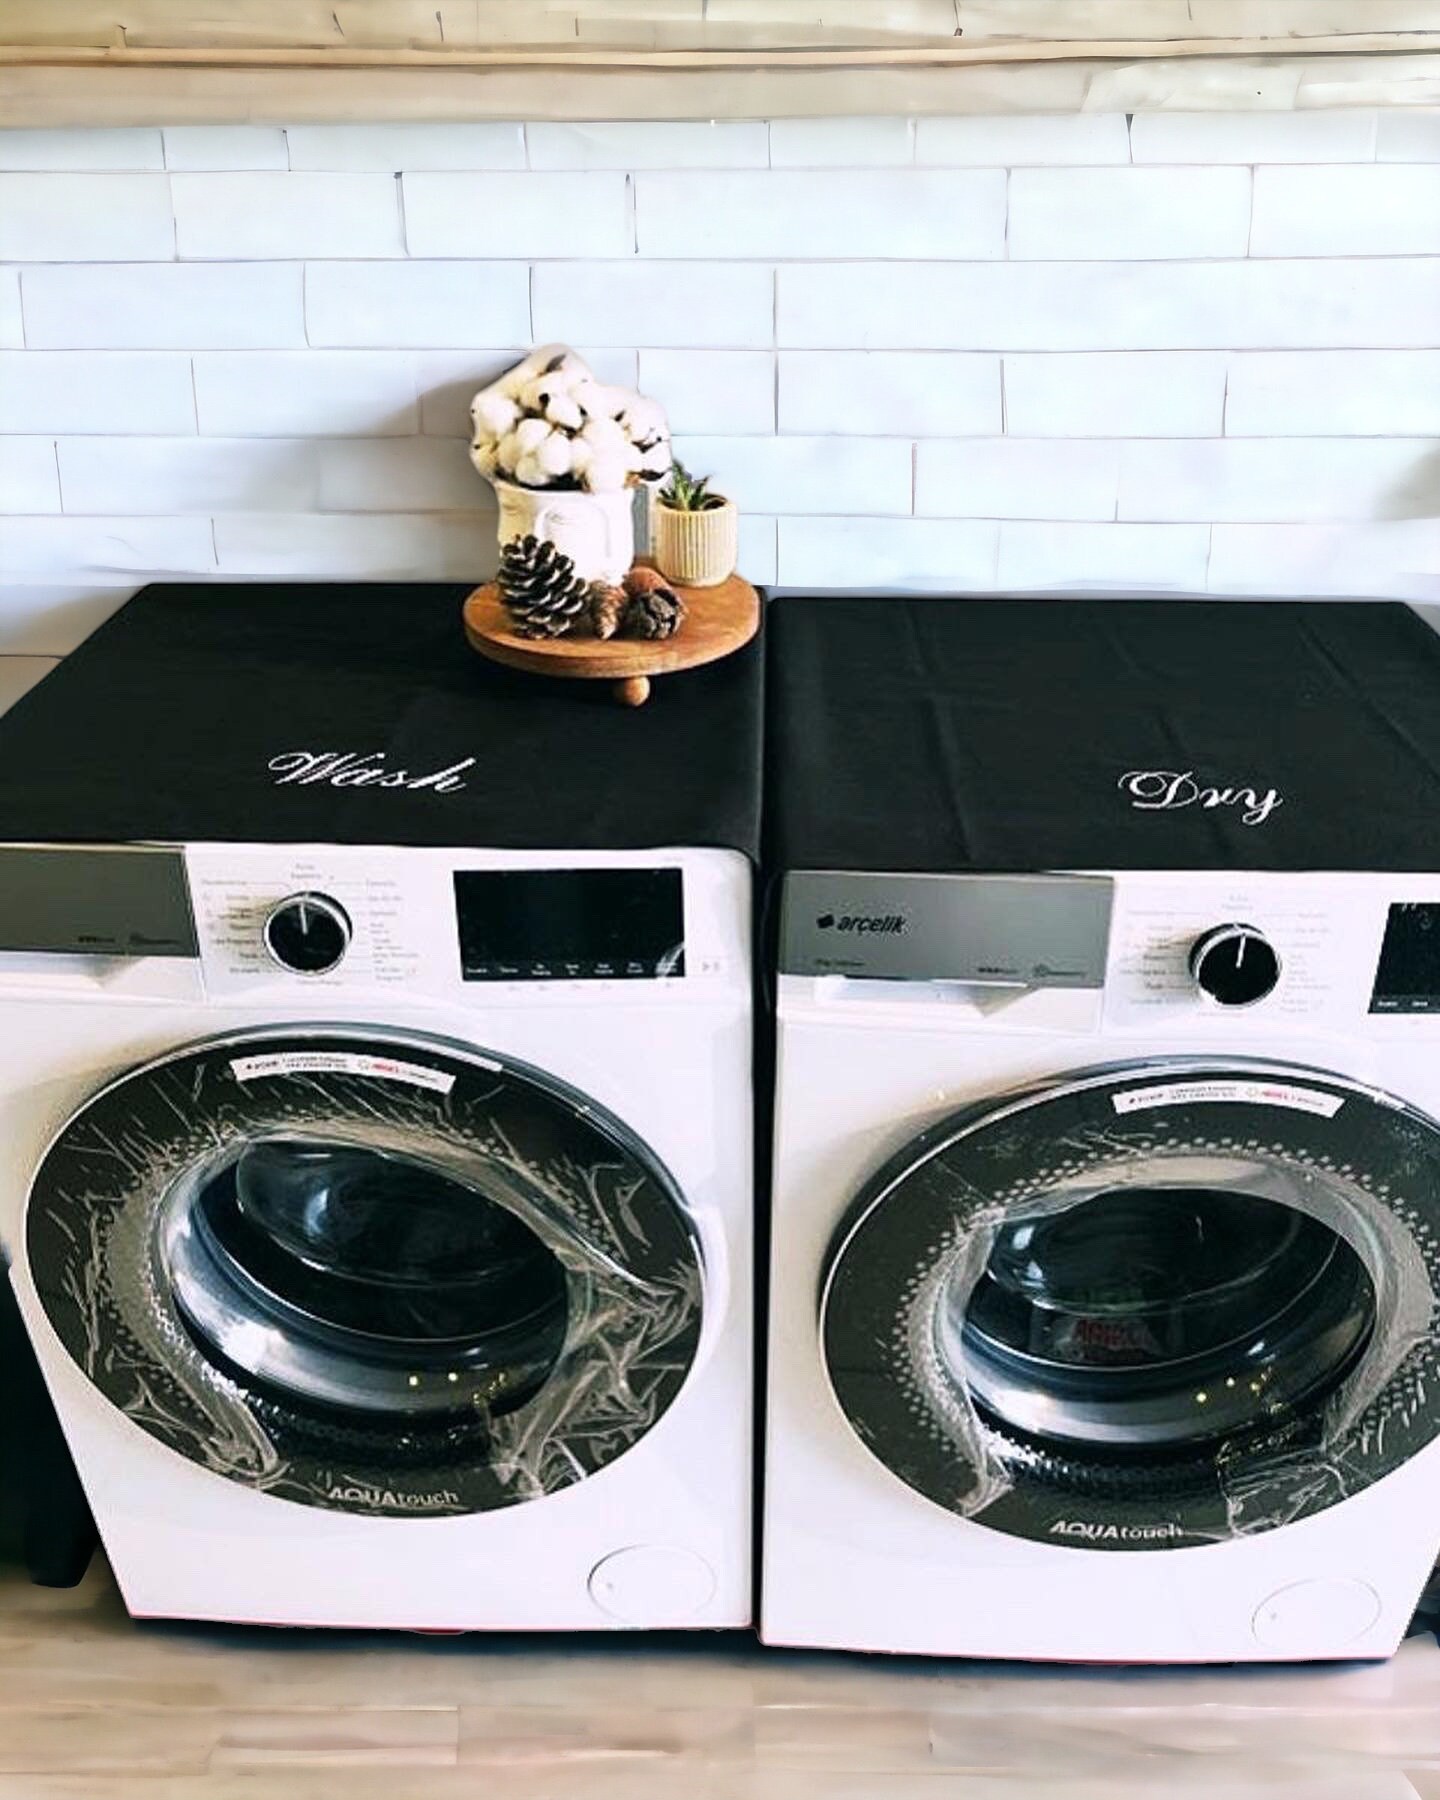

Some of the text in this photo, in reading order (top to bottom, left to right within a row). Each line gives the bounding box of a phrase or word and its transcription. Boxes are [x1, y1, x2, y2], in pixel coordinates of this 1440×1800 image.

[267, 752, 476, 792] Wash
[1117, 770, 1284, 825] Dry
[837, 915, 906, 936] arçelik
[328, 1486, 459, 1507] AQUAtouch
[1049, 1519, 1184, 1541] AQUAtouch
